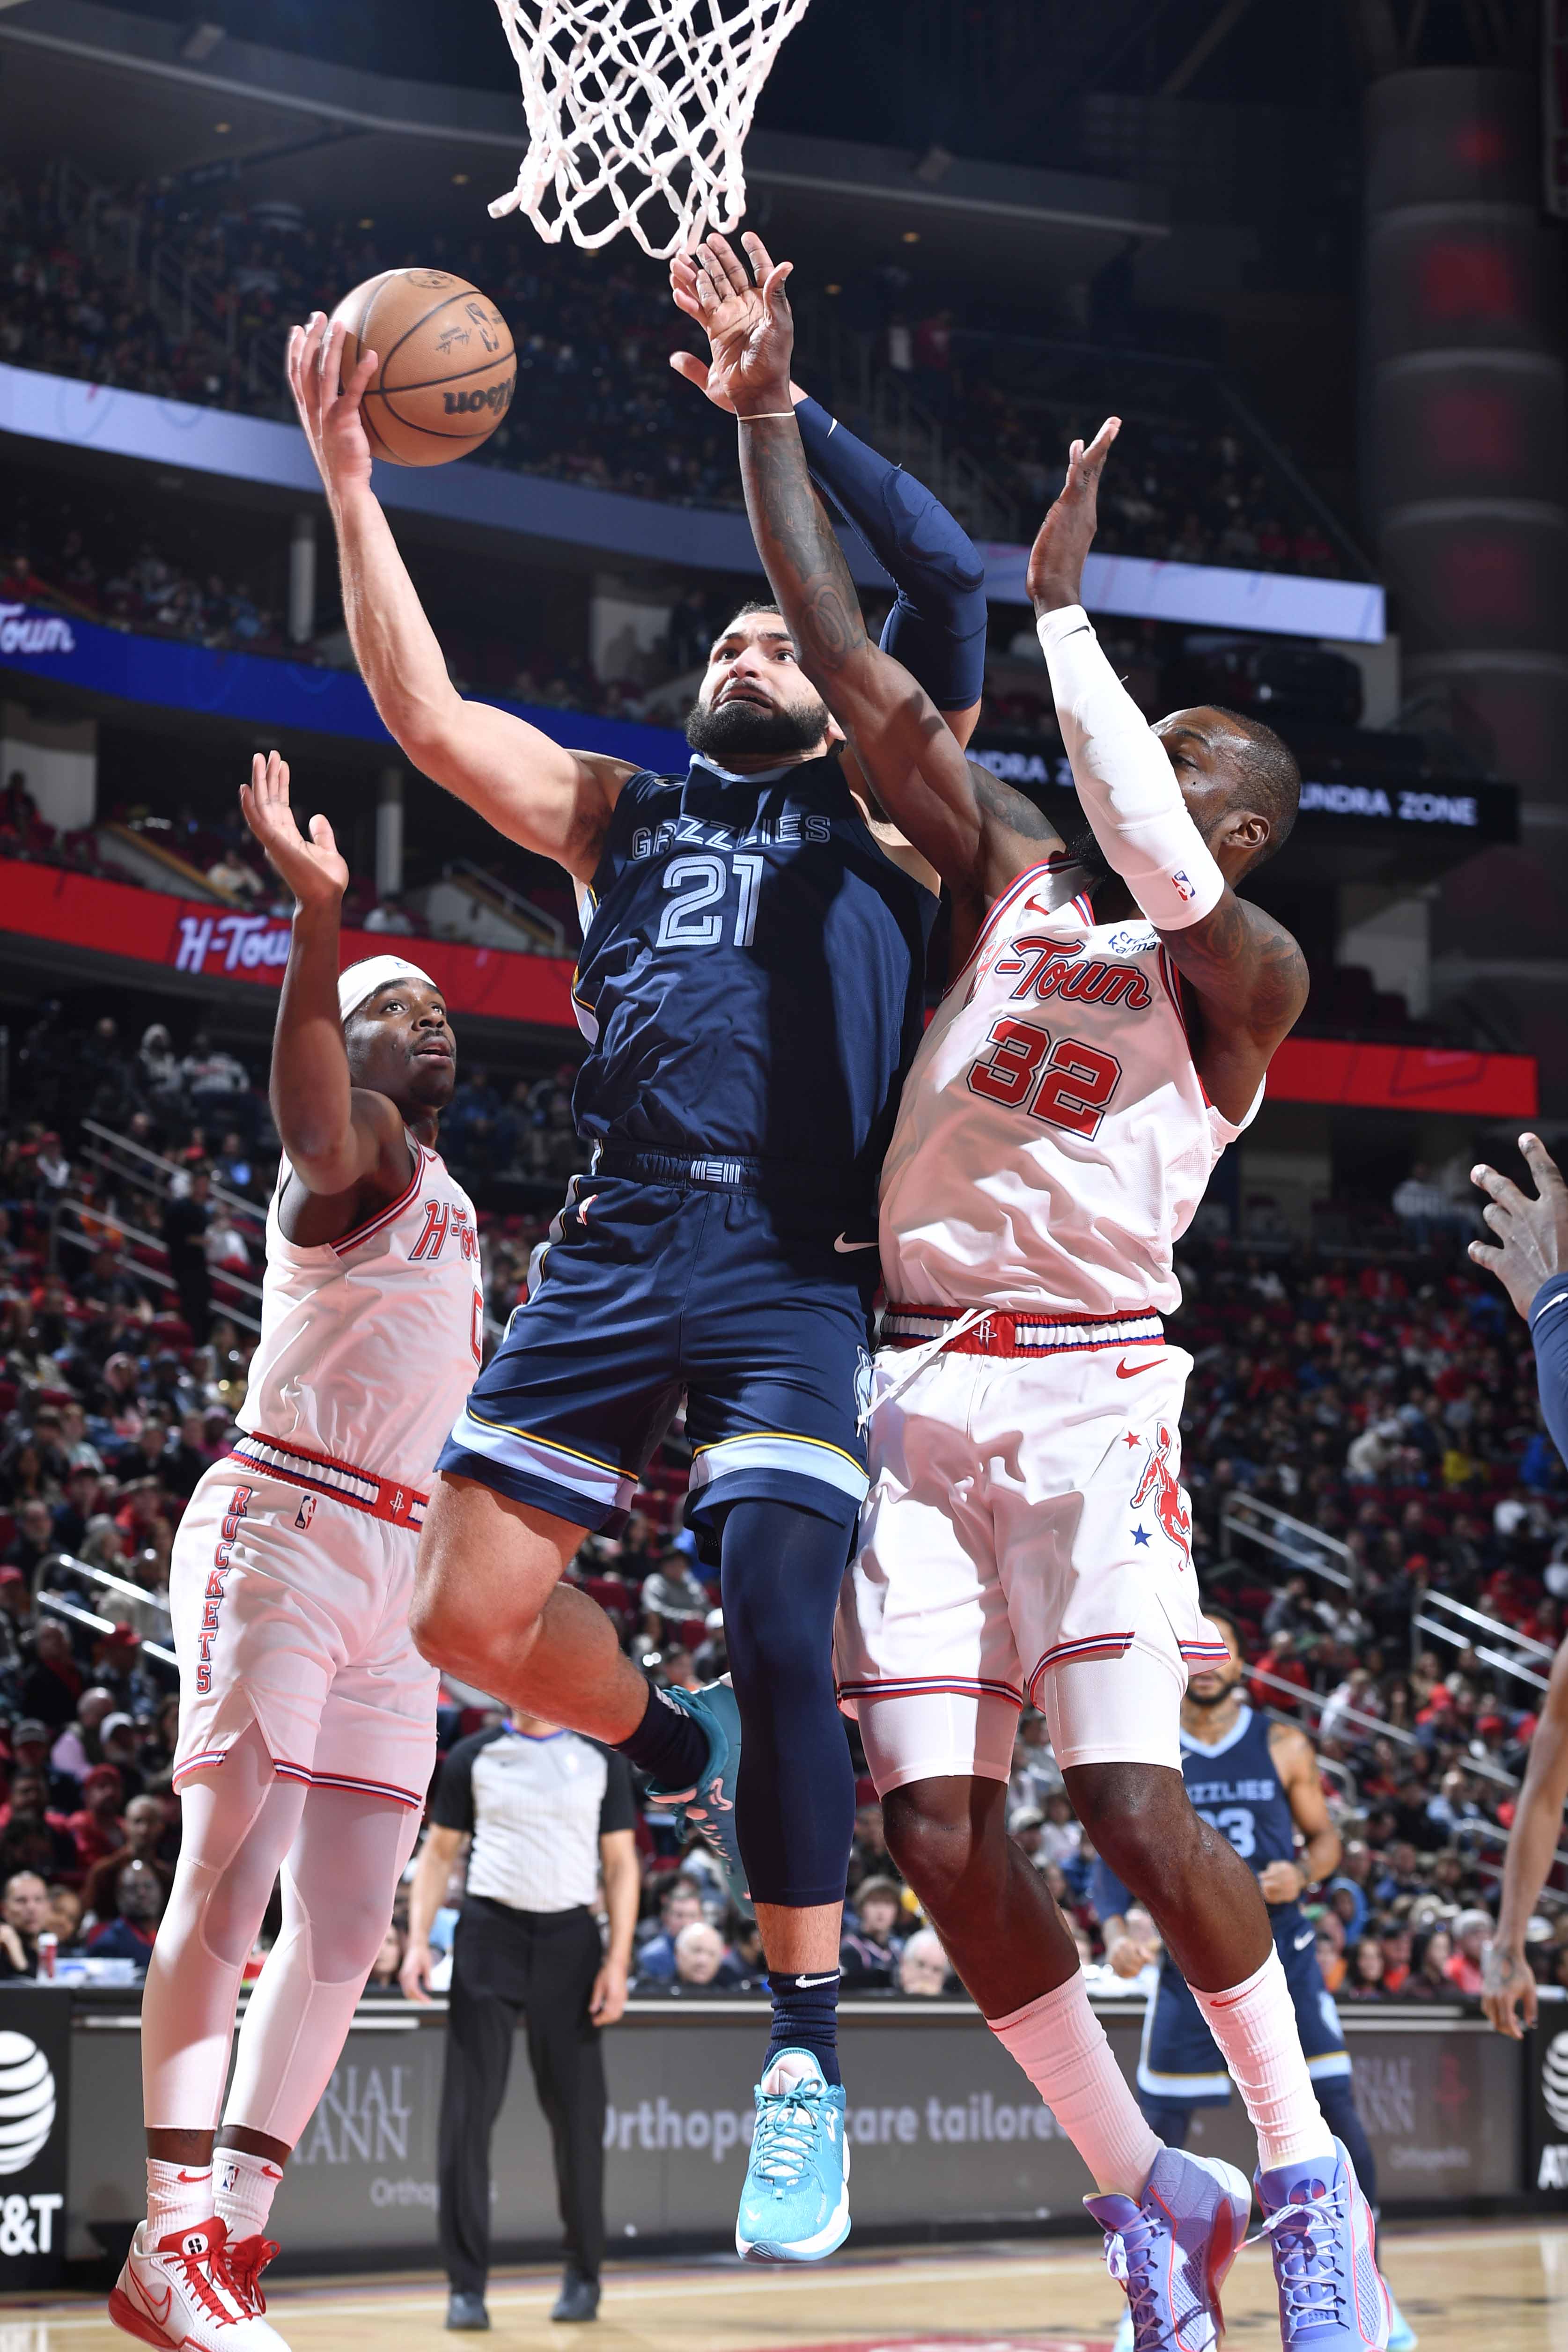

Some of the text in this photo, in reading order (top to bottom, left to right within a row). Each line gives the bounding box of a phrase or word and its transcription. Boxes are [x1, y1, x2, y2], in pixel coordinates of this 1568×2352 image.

[1299, 782, 1478, 826] UNDRA ZONE
[632, 813, 831, 860] GRZZLIES
[655, 854, 764, 948] 21
[175, 915, 293, 974] H-Tow
[965, 1015, 1123, 1142] 32
[196, 1485, 253, 1695] ROCKETS
[844, 2105, 918, 2144] are
[0, 2193, 64, 2256] &T
